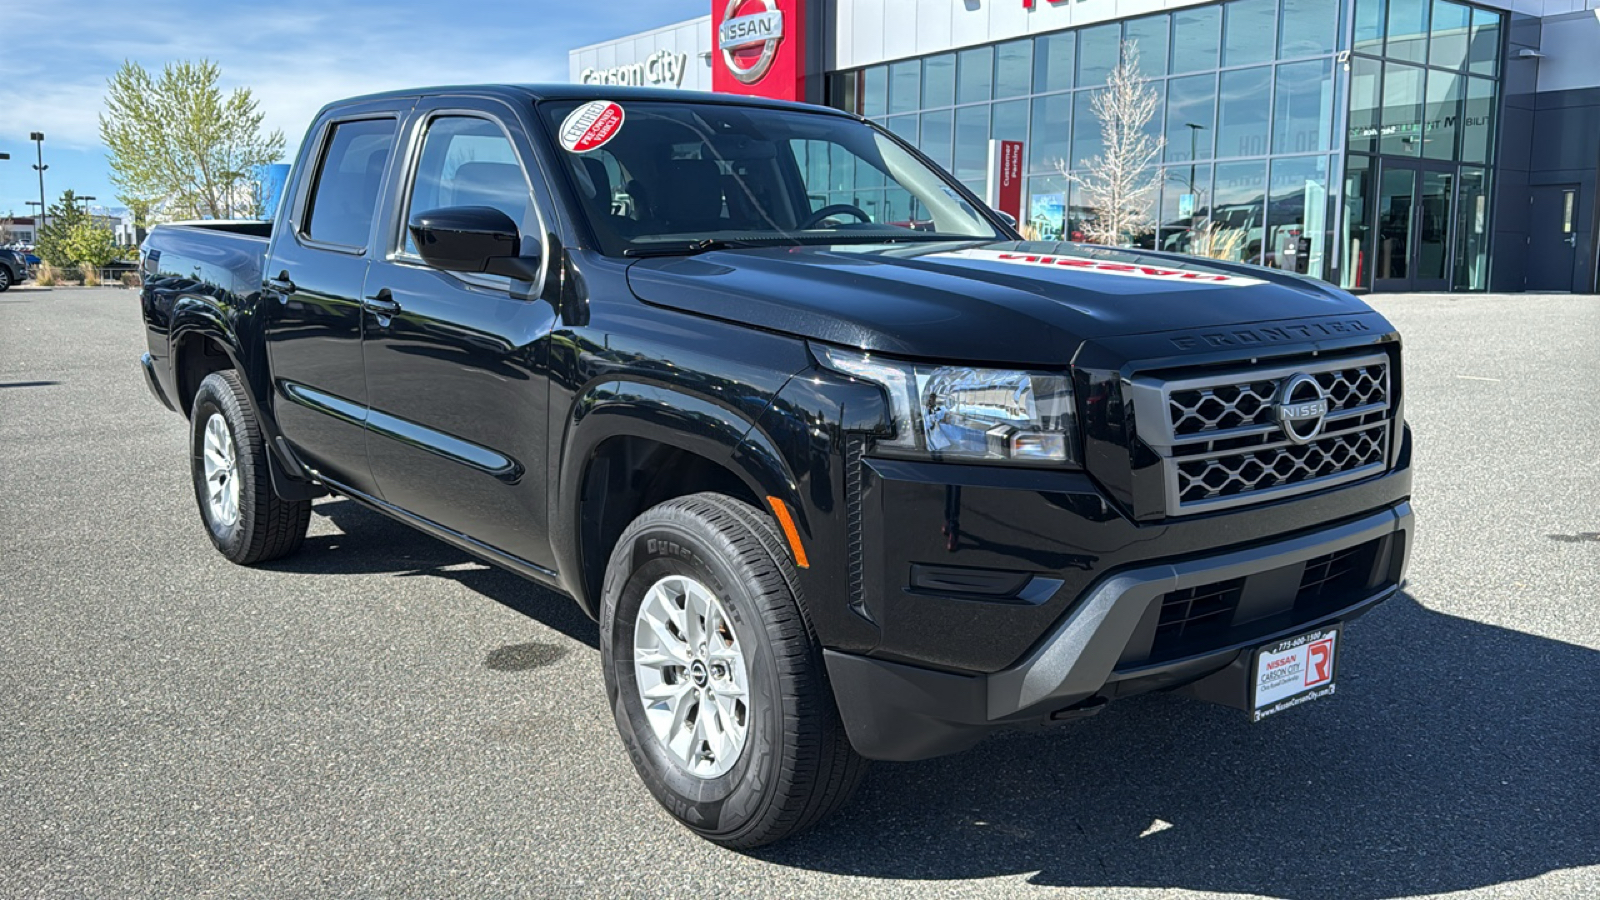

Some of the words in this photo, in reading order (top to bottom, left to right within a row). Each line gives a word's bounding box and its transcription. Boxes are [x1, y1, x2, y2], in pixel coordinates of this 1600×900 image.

[719, 17, 772, 43] NISSAN
[580, 66, 645, 87] Carson
[645, 48, 687, 89] City
[564, 102, 606, 142] CERTIFIED
[580, 108, 615, 146] PRE-OWNED
[593, 115, 620, 141] VEHICLE
[1003, 143, 1011, 187] Customer
[1011, 144, 1020, 179] Parking
[1169, 319, 1370, 351] FRONTIER
[1260, 667, 1287, 683] CARSON
[1288, 662, 1301, 675] CITY
[1266, 654, 1297, 671] NISSAN
